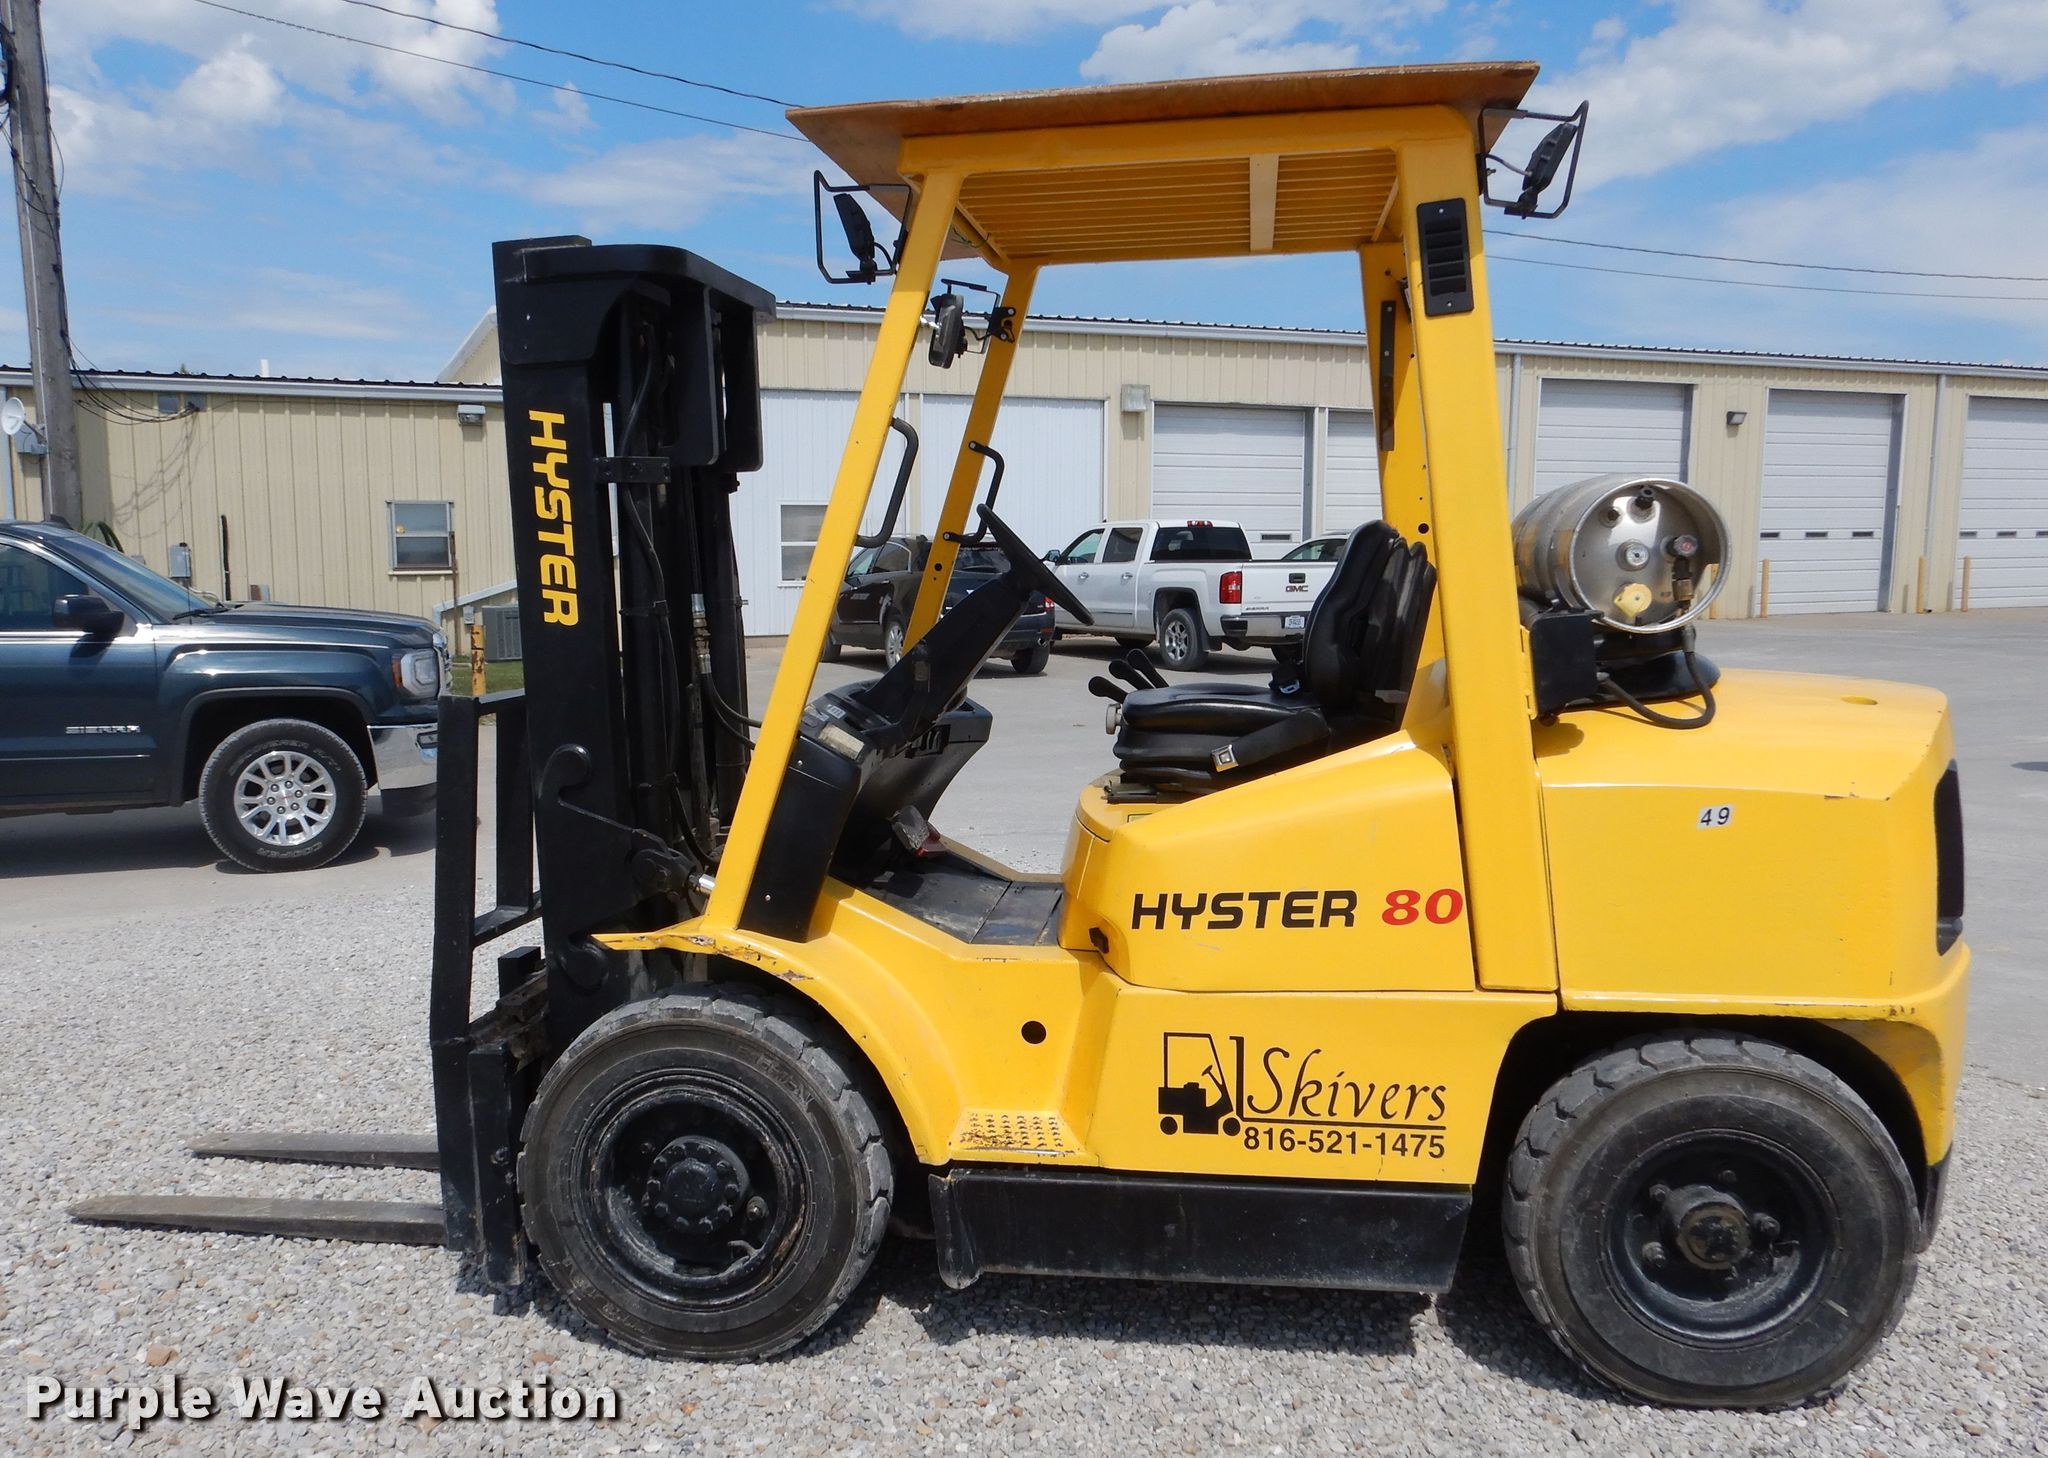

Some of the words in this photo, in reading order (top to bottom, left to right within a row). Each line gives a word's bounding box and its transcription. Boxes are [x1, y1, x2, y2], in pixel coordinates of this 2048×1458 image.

[528, 409, 580, 627] HYSTER
[65, 725, 141, 734] SIERRA
[1700, 806, 1730, 826] 49
[1131, 890, 1358, 930] HYSTER
[1381, 888, 1464, 926] 80
[1246, 1046, 1447, 1121] Skivers
[1243, 1127, 1446, 1159] 816-521-1475
